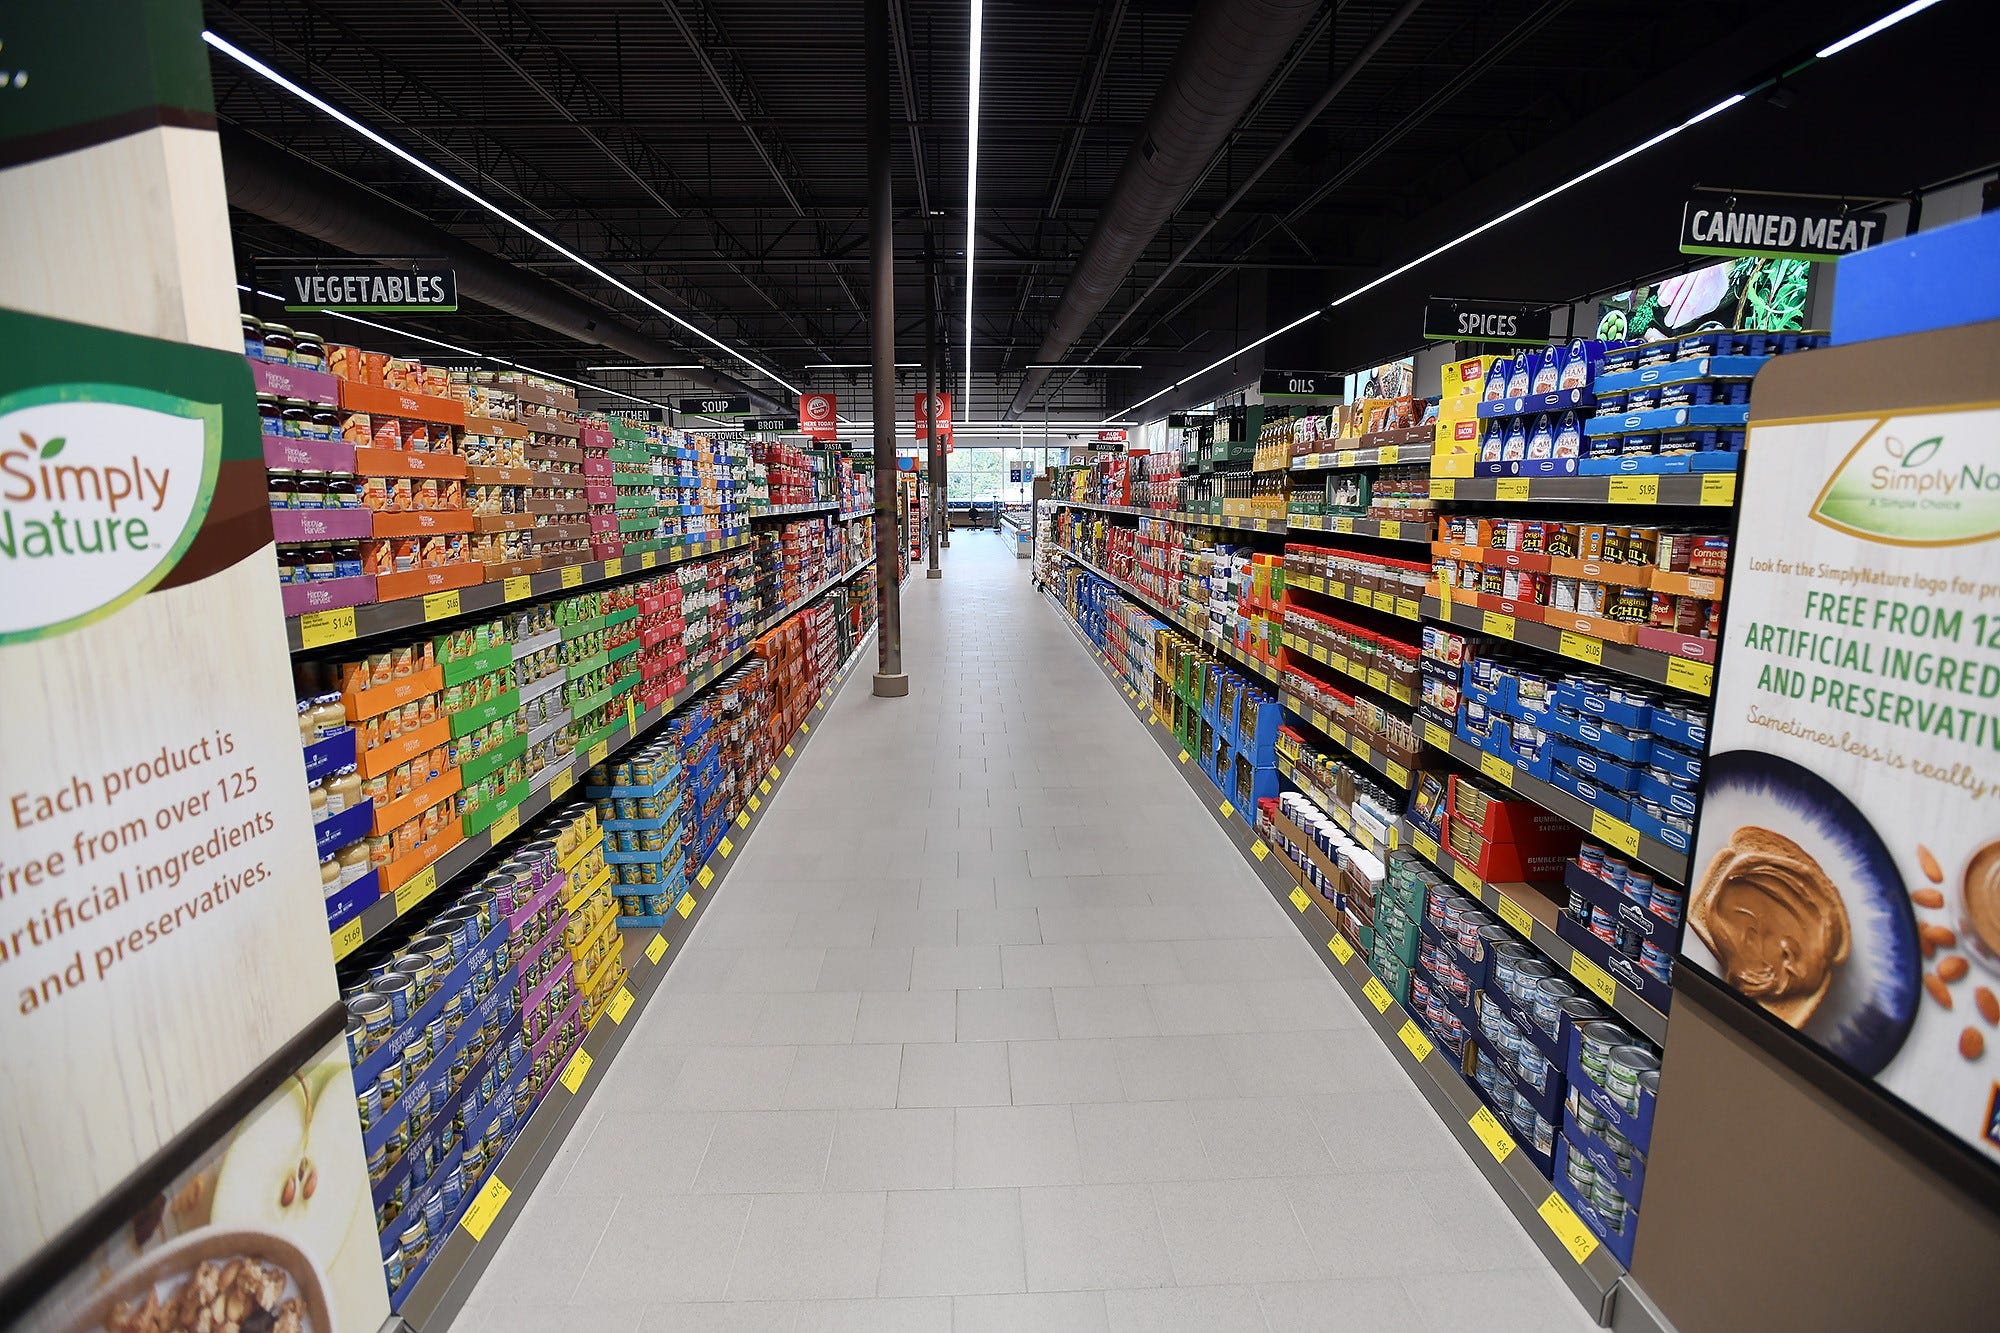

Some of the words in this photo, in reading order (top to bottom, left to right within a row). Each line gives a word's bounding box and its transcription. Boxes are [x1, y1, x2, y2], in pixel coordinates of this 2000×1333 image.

[1692, 210, 1797, 247] CANNED
[1800, 217, 1877, 251] MEAT
[294, 276, 445, 303] VEGETABLES
[1458, 312, 1517, 336] SPICES
[1465, 366, 1479, 375] BACON
[1538, 373, 1557, 381] HAM
[1564, 366, 1585, 376] HAM
[1288, 379, 1315, 393] OILS
[1510, 377, 1527, 387] HAM
[701, 400, 729, 413] SOUP
[758, 421, 784, 430] BROTH
[1458, 427, 1473, 436] BACON
[1558, 437, 1578, 447] HAM
[0, 451, 169, 513] Simply
[1639, 484, 1656, 495] $1.95
[1750, 557, 1774, 573] Look
[1777, 560, 1794, 575] for
[1796, 563, 1816, 578] the
[1817, 564, 1911, 588] SimplyNature
[1914, 572, 1948, 596] logo
[1951, 576, 1976, 594] for
[447, 600, 459, 610] $1.65
[333, 616, 353, 630] $1.49
[1805, 590, 1867, 628] FREE
[1873, 600, 1964, 643] FROM
[1585, 644, 1600, 657] $1.05
[1744, 622, 1873, 674] ARTIFICIAL
[1757, 663, 1806, 700] AND
[1747, 704, 1840, 749] Sometimes
[1840, 731, 1883, 764] less
[1887, 748, 1906, 769] is
[1911, 758, 1985, 799] really
[10, 776, 93, 829] Each
[102, 737, 212, 805] product
[216, 730, 235, 757] is
[72, 818, 148, 867] from
[156, 790, 210, 831] over
[217, 766, 258, 804] 125
[1625, 835, 1637, 848] 47¢
[136, 809, 275, 894] ingredients
[19, 953, 86, 1016] and
[94, 860, 272, 981] preservatives.
[343, 926, 361, 947] $1.69
[1597, 978, 1614, 997] $2.89
[1496, 1139, 1509, 1155] 65¢
[490, 1182, 503, 1199] 47¢
[1574, 1235, 1590, 1253] 67¢
